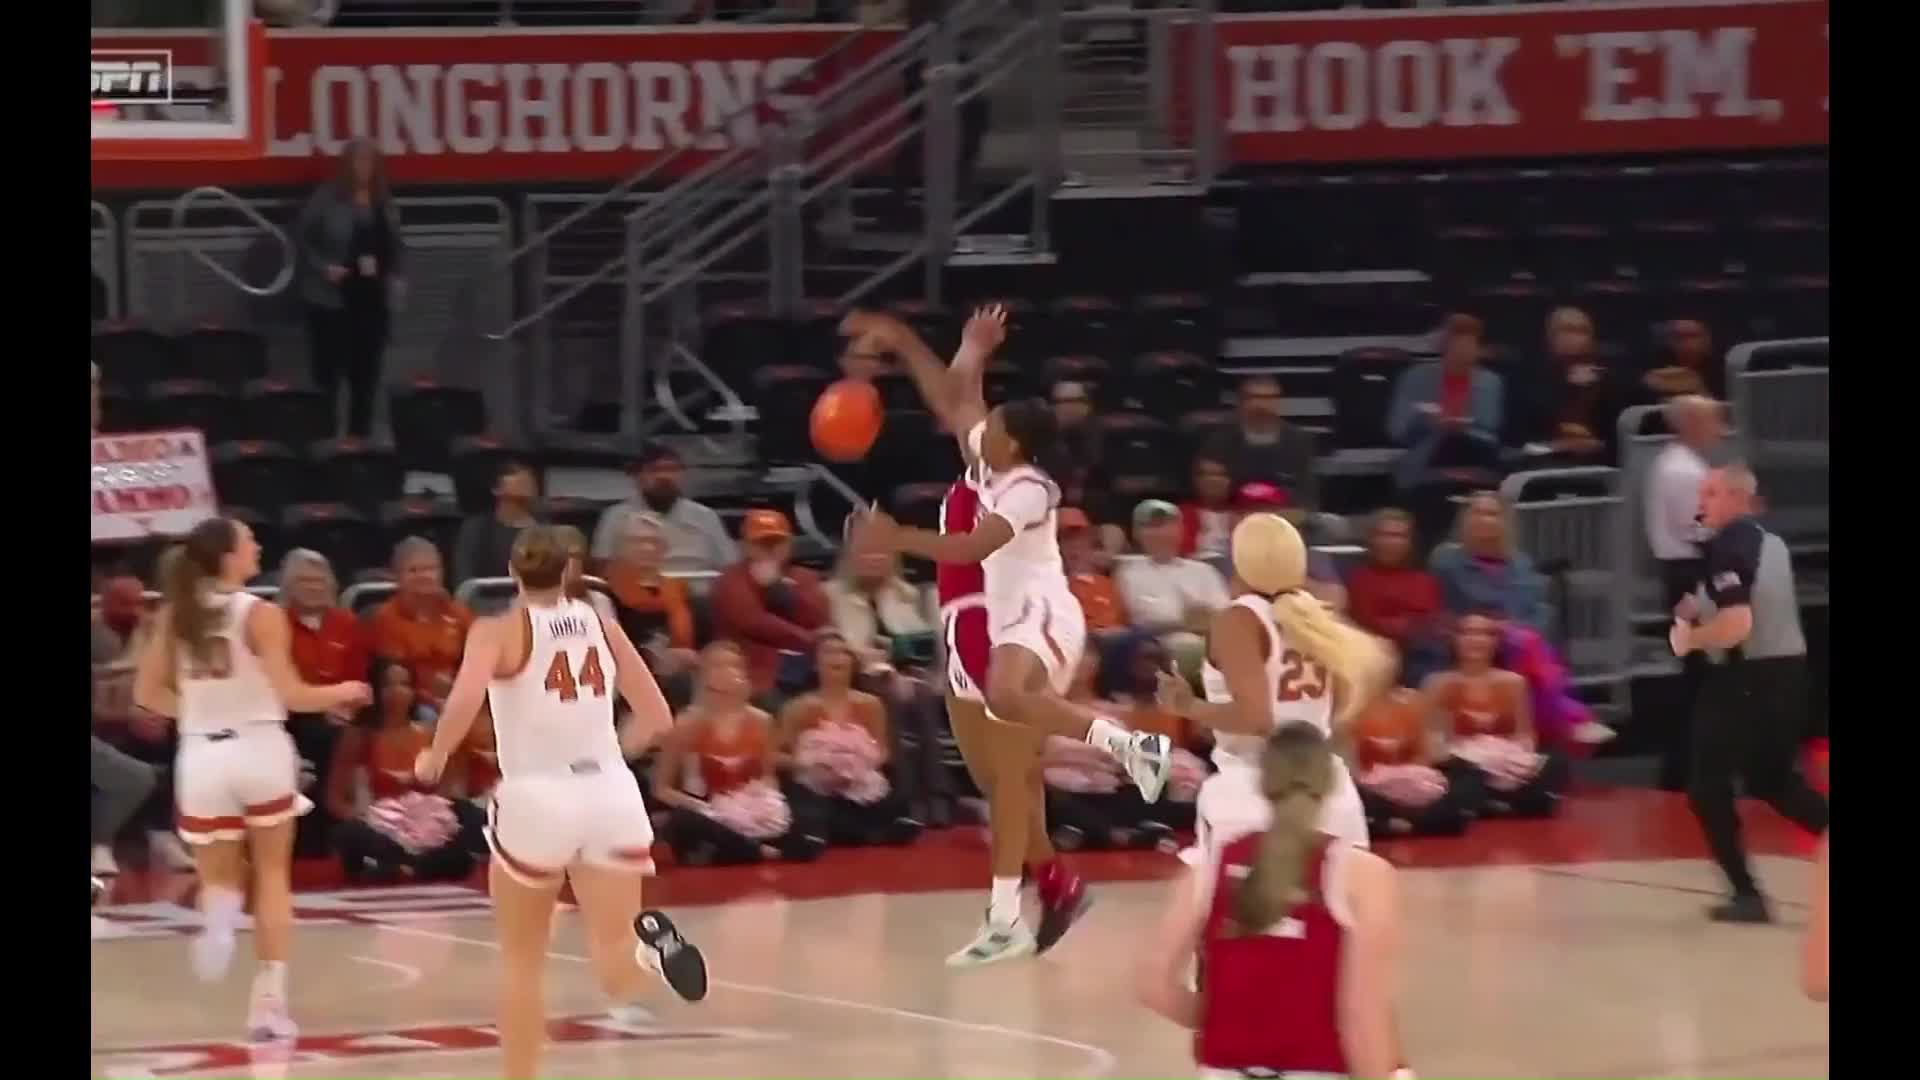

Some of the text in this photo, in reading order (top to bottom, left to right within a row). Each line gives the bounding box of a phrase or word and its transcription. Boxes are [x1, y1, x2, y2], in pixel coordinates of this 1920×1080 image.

[1225, 37, 1521, 133] HOOK
[544, 646, 606, 703] 44
[1278, 650, 1328, 702] 23
